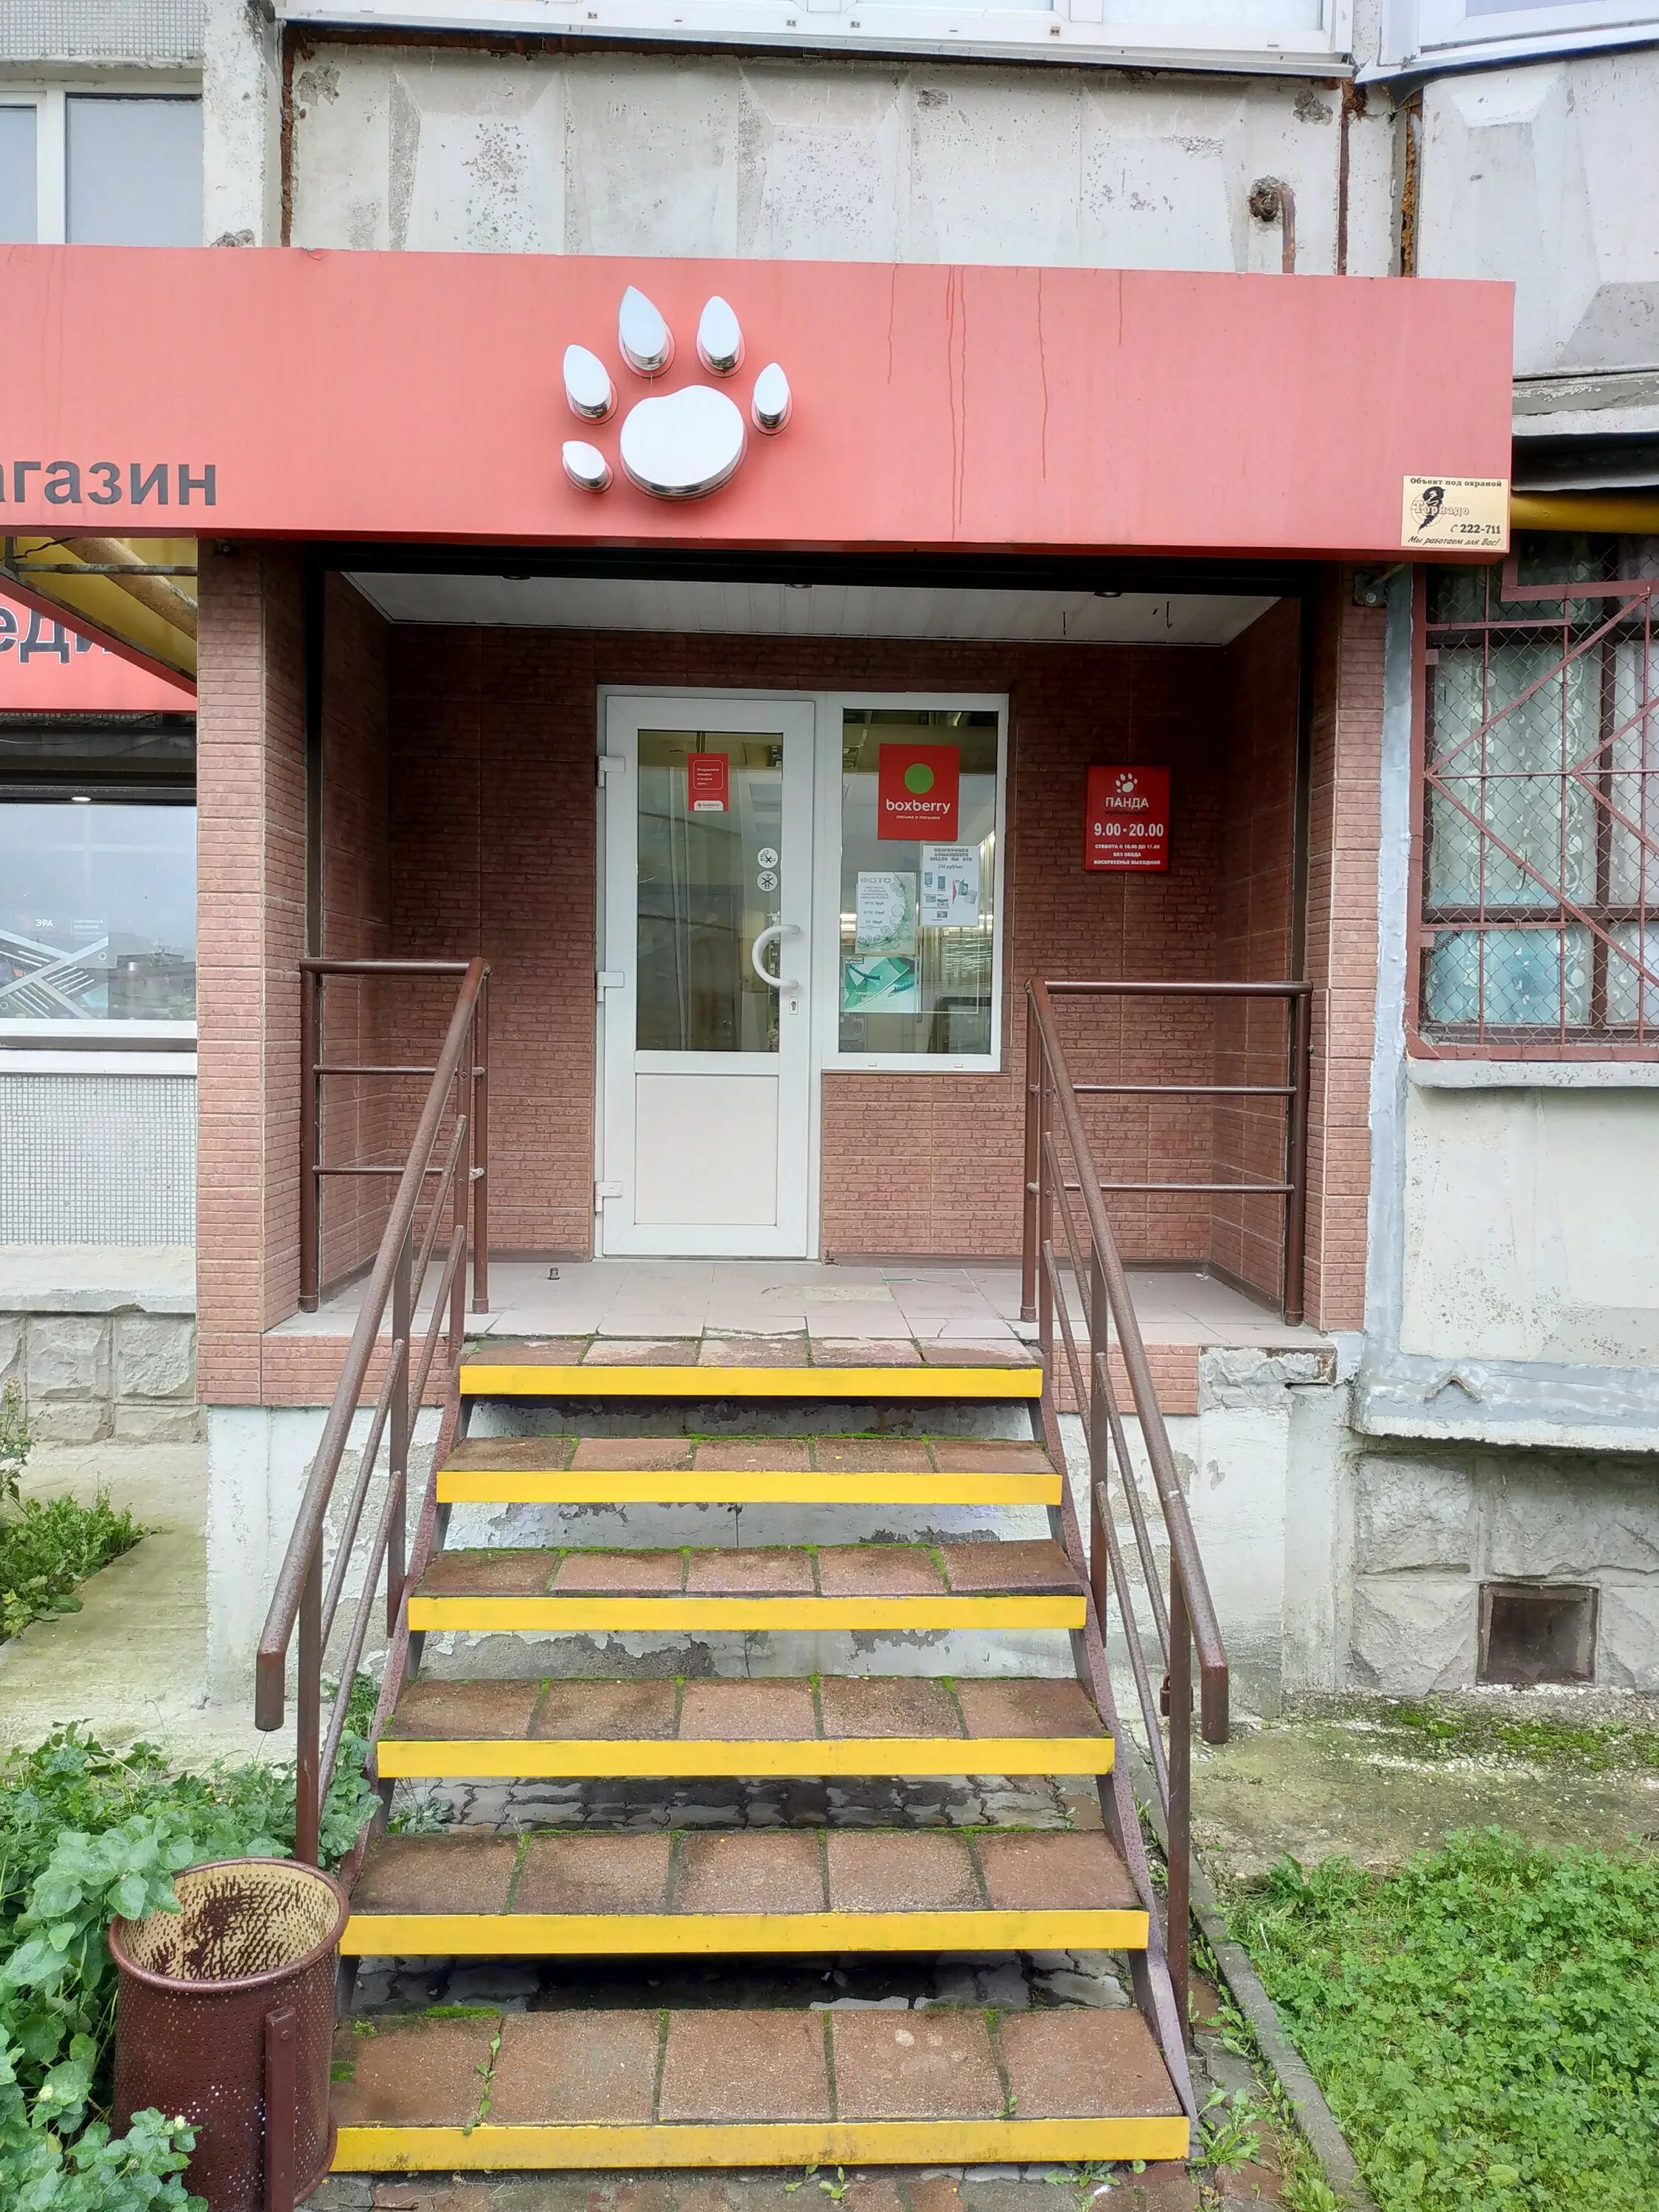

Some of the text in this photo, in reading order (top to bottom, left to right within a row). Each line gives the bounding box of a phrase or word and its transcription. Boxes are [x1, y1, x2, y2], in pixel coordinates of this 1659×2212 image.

[0, 461, 217, 506] газин
[1412, 501, 1470, 517] Торнадо
[1460, 524, 1500, 535] 222-711
[1408, 535, 1422, 544] Мы
[1481, 538, 1500, 546] Вас!
[886, 799, 951, 815] boxberry
[1105, 797, 1150, 810] ПАНДА
[35, 919, 54, 927] ЭРА
